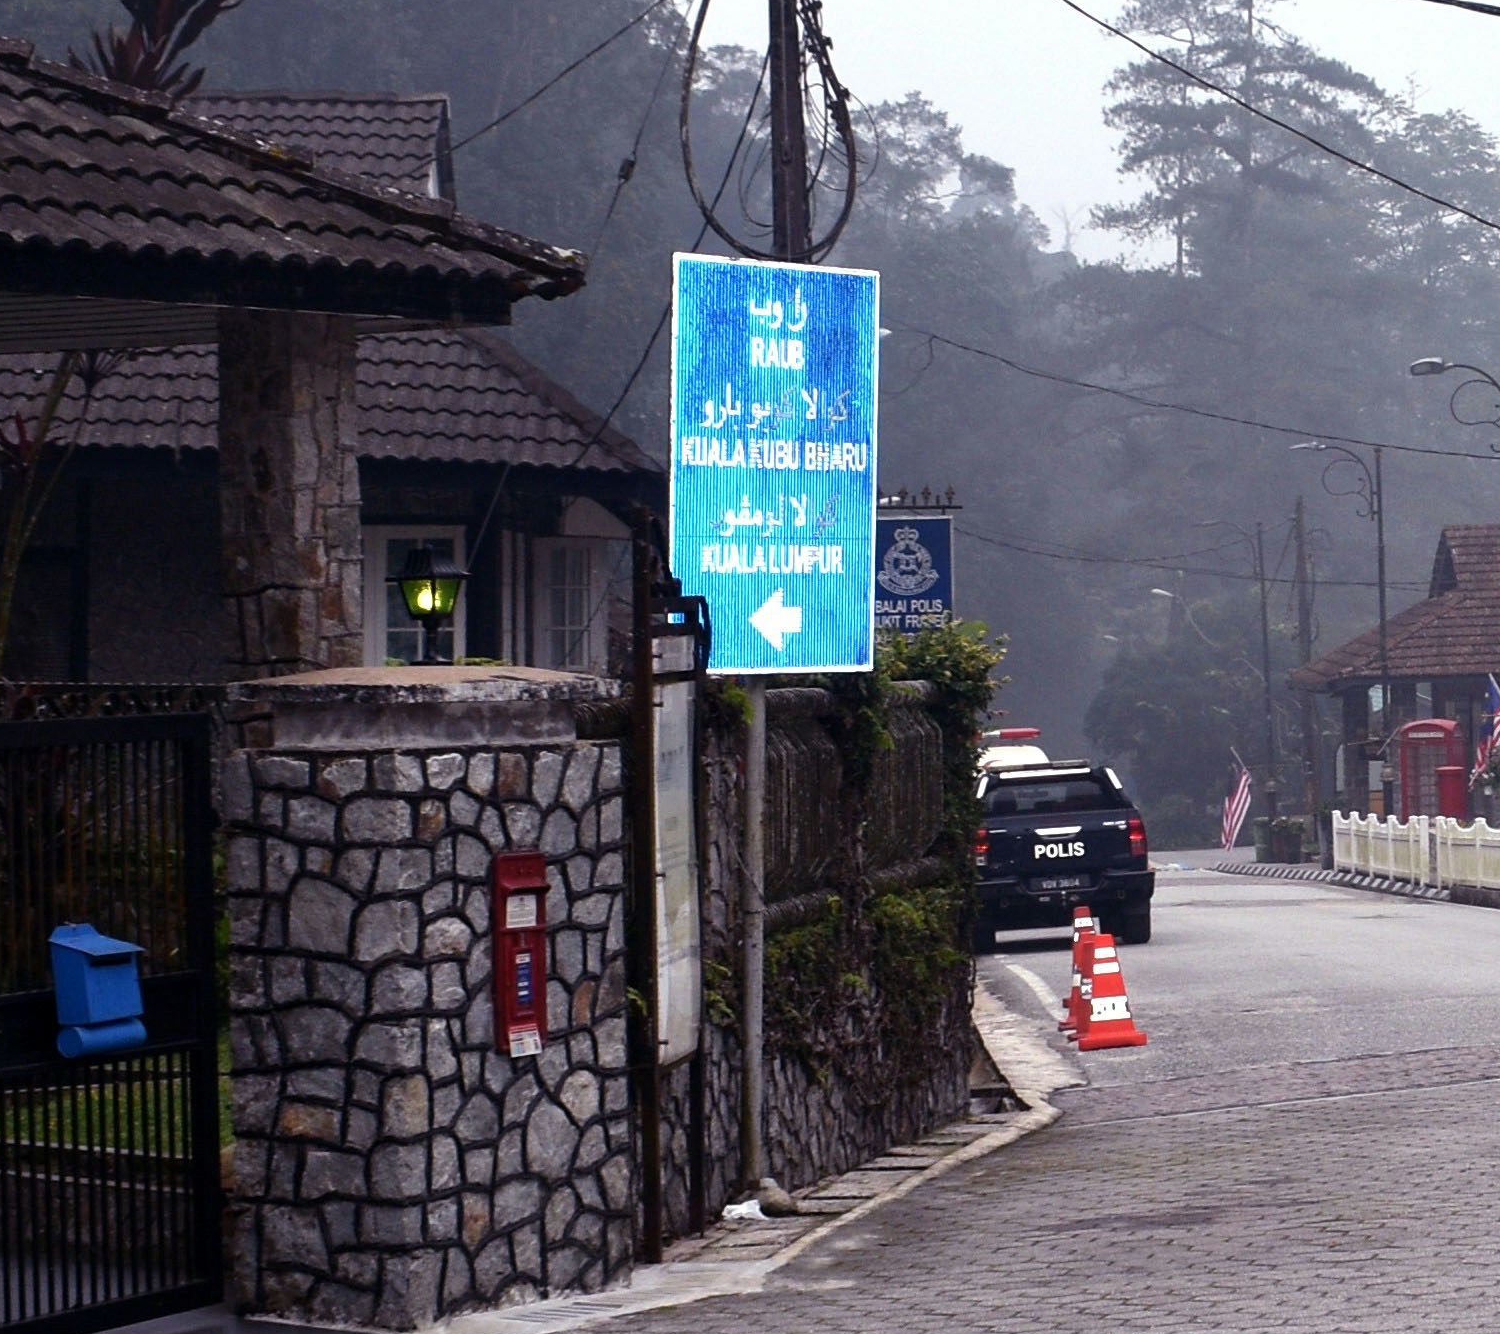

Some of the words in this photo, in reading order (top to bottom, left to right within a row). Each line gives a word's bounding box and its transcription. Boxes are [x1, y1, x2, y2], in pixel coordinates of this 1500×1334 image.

[752, 337, 804, 370] RAUB
[682, 436, 746, 467] KUALA
[749, 438, 799, 469] KUBU
[805, 441, 867, 471] BHARU
[702, 543, 766, 573] KUALA
[770, 544, 844, 574] LUMPUR
[876, 599, 907, 613] BALAI
[911, 598, 943, 613] POLIS
[1034, 841, 1085, 859] POLIS
